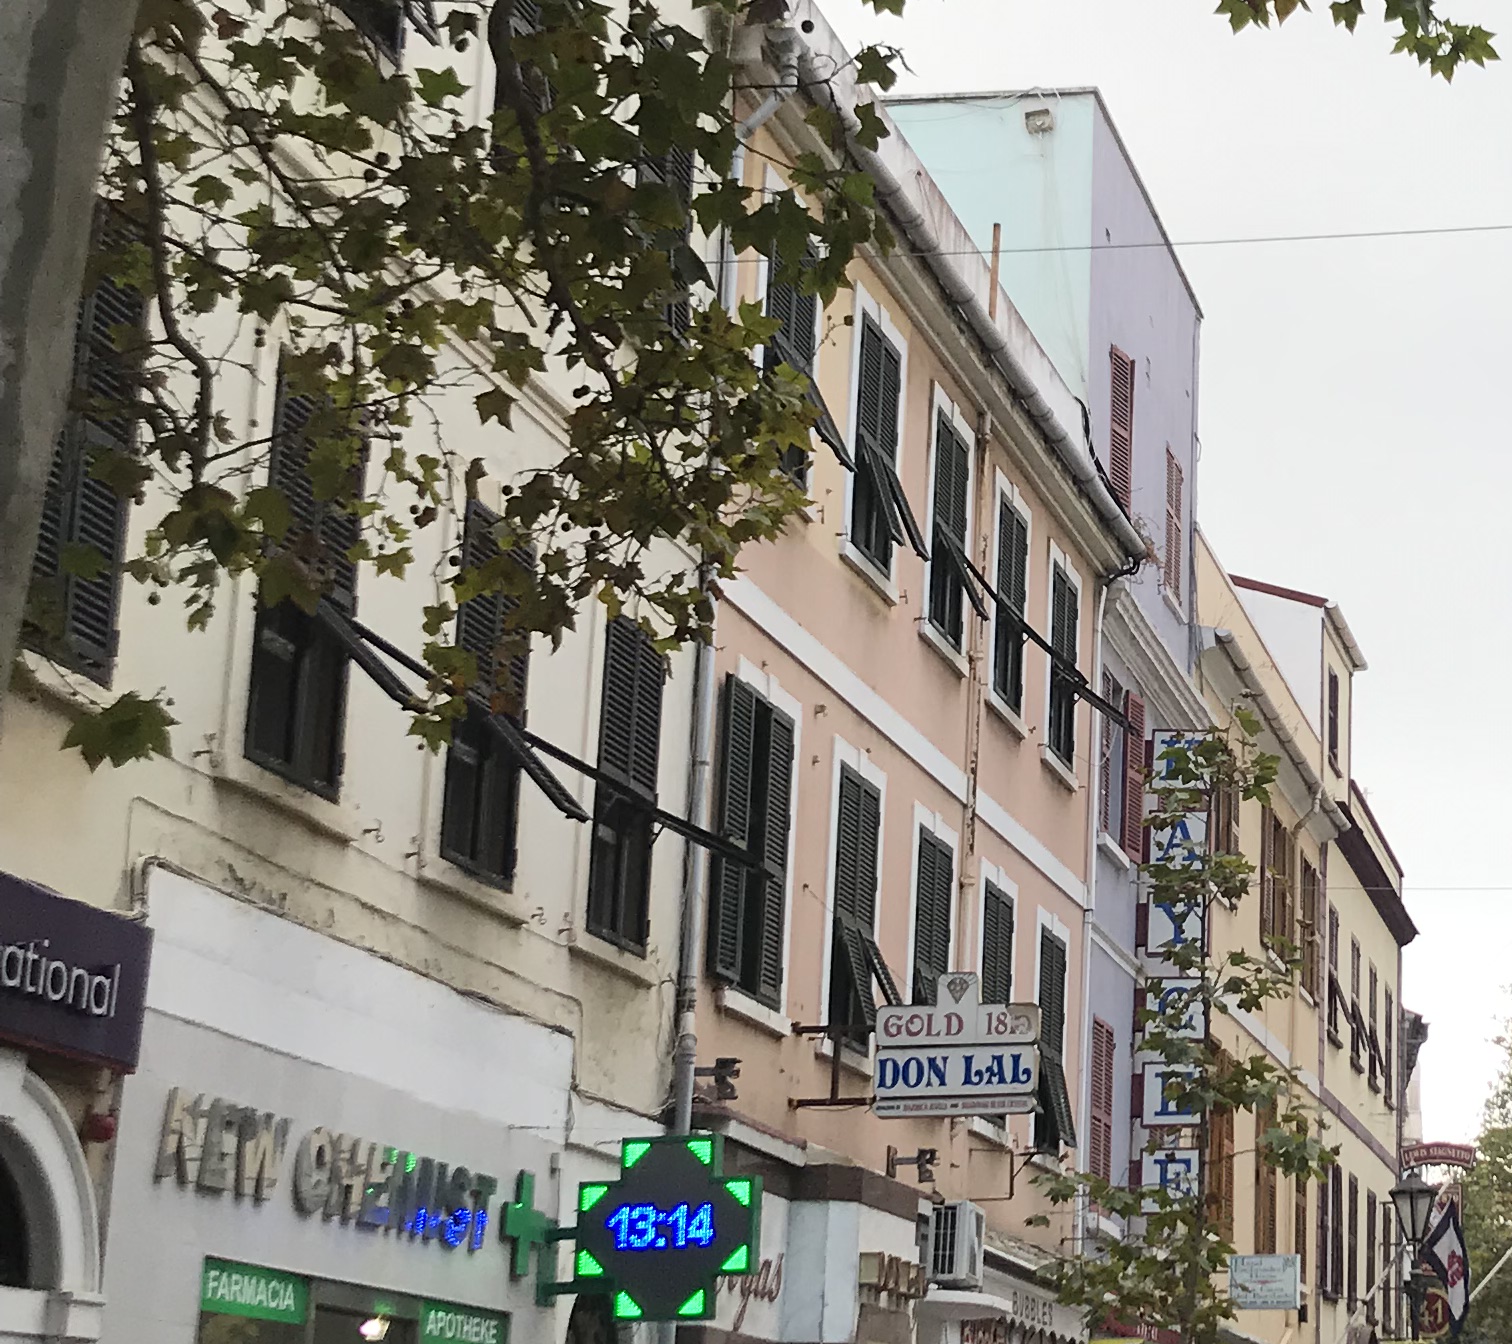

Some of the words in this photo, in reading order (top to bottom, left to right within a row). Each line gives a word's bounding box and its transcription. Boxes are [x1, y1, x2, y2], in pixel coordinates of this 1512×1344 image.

[1, 938, 121, 1018] ational
[883, 1012, 964, 1038] GOLD
[877, 1056, 949, 1089] DON
[961, 1053, 1033, 1086] LAL
[153, 1087, 293, 1204] NEW
[292, 1126, 498, 1253] CHEMIST
[606, 1202, 715, 1250] 13:14
[206, 1270, 295, 1312] FARMACIA
[1012, 1291, 1053, 1327] BUBBLES
[425, 1309, 498, 1344] APOTHEKE
